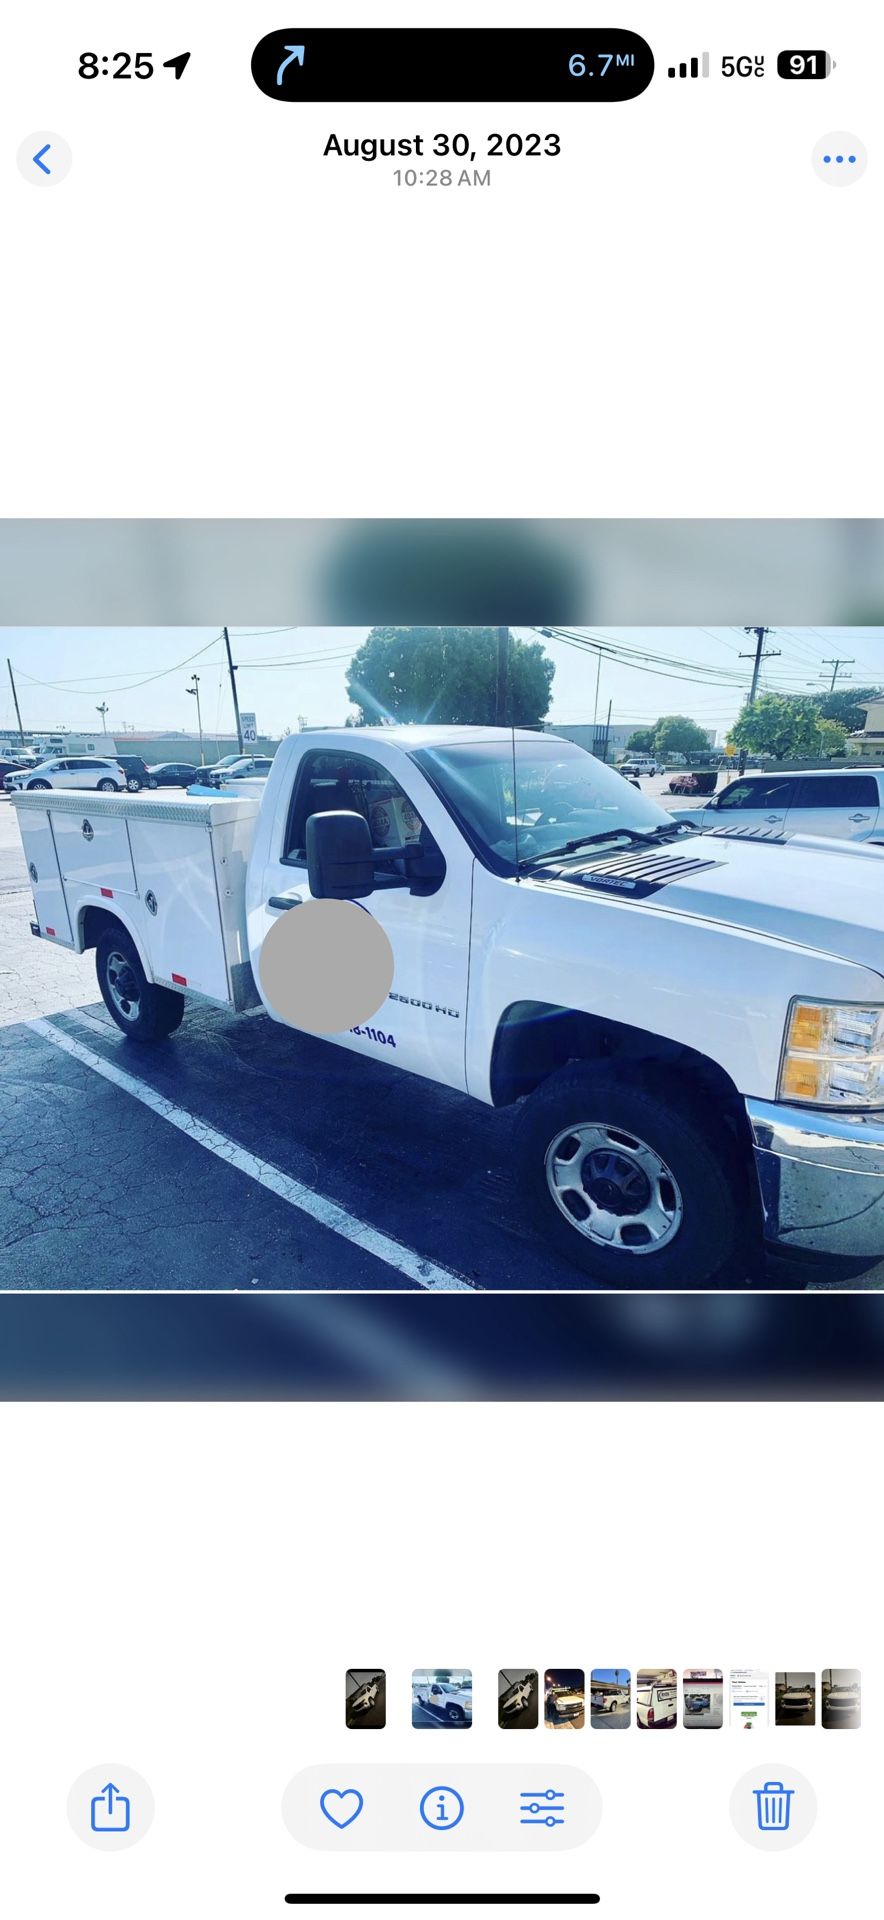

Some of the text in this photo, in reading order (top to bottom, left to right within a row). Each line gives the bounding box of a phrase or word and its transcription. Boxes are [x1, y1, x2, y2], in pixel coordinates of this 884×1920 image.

[77, 52, 154, 80] 8:25
[789, 54, 817, 75] 91
[323, 133, 561, 161] August 30, 2023
[393, 169, 491, 187] 10:28 AM
[243, 730, 256, 741] 40
